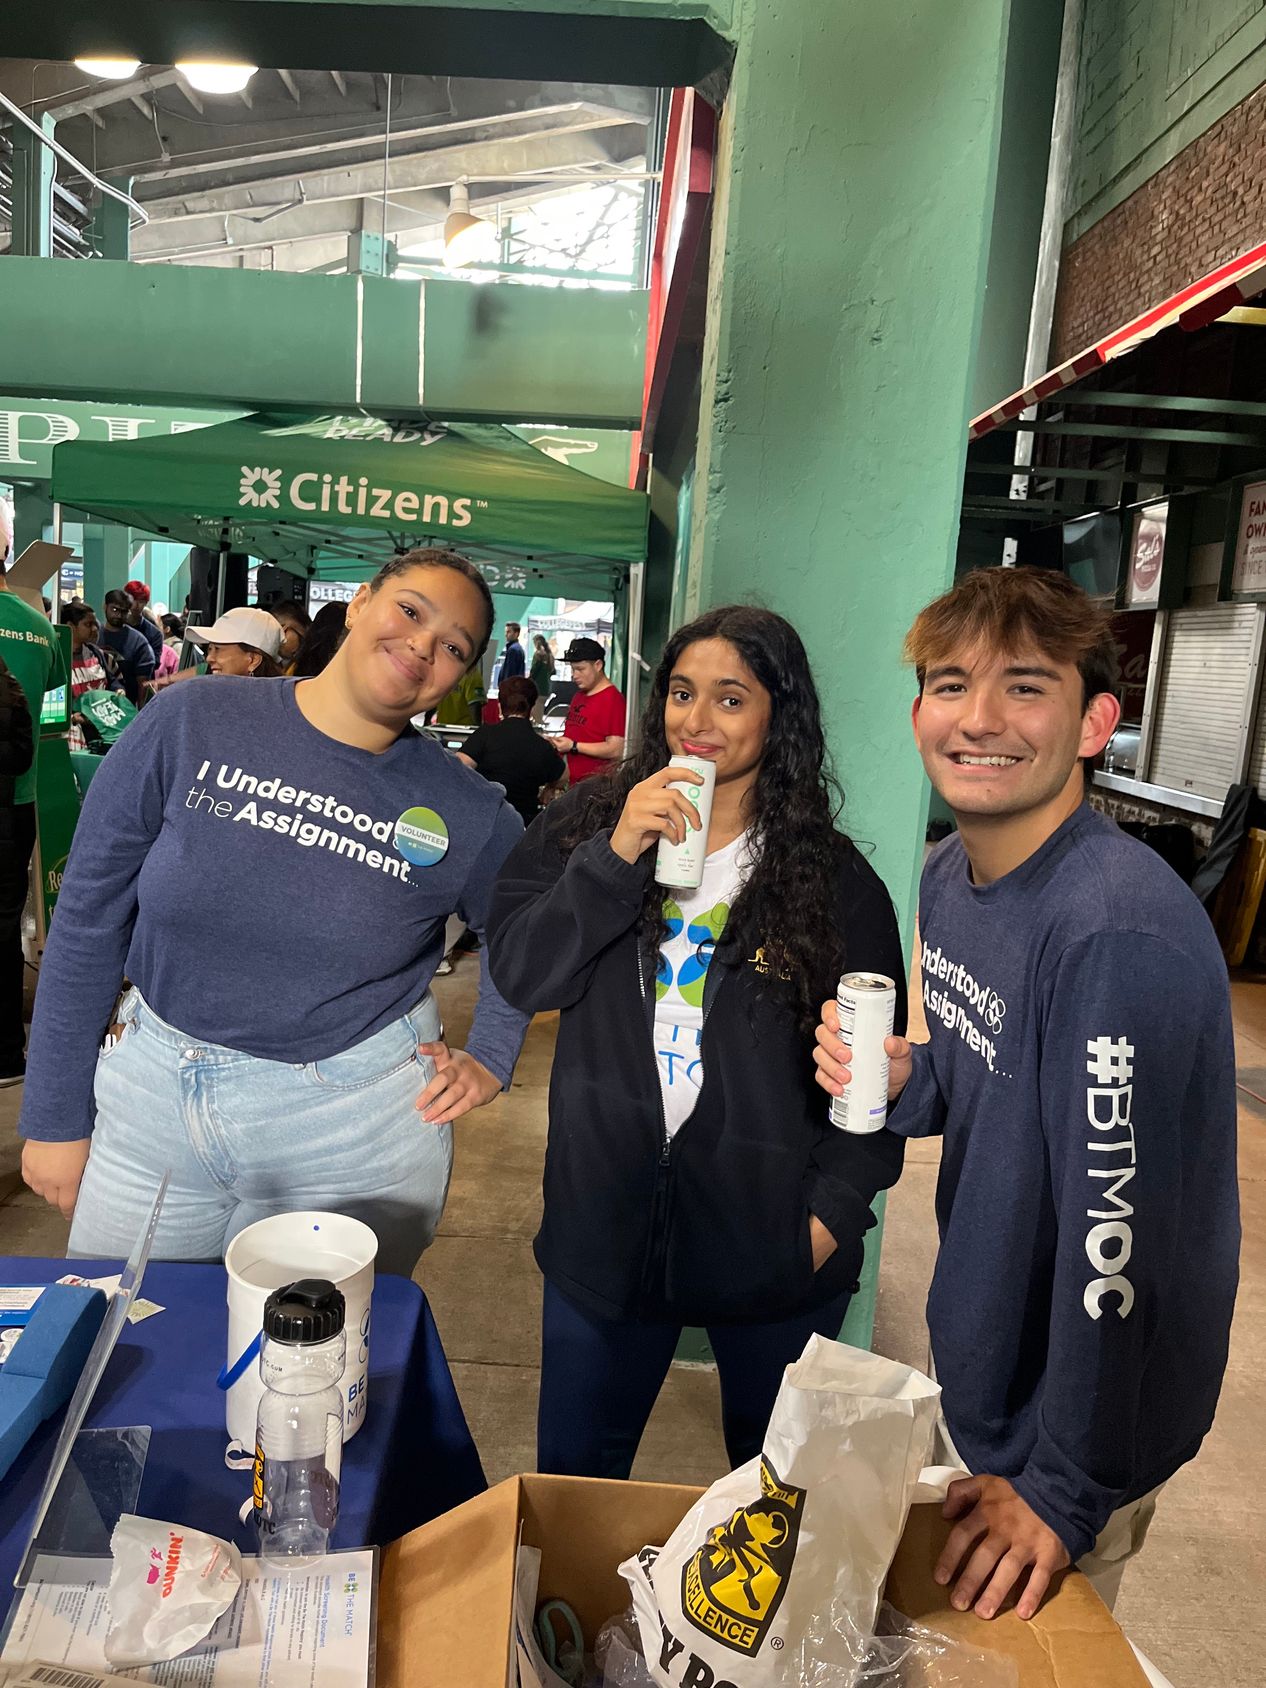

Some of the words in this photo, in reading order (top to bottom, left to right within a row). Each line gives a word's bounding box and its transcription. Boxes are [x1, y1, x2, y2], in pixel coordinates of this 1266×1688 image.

[323, 426, 448, 446] READY
[289, 472, 472, 527] Citizens
[310, 587, 357, 603] OLLEG
[0, 627, 24, 640] zens
[185, 785, 233, 818] the
[196, 760, 211, 781] I
[216, 763, 394, 844] Understood
[401, 825, 446, 846] VOLUNTEER
[1083, 1036, 1137, 1320] #BTMOC
[348, 1374, 365, 1402] BE
[162, 1531, 184, 1598] DUNKIN'
[348, 1573, 356, 1582] BE
[321, 1592, 330, 1619] Screening
[346, 1594, 355, 1608] THE
[320, 1620, 328, 1648] Document
